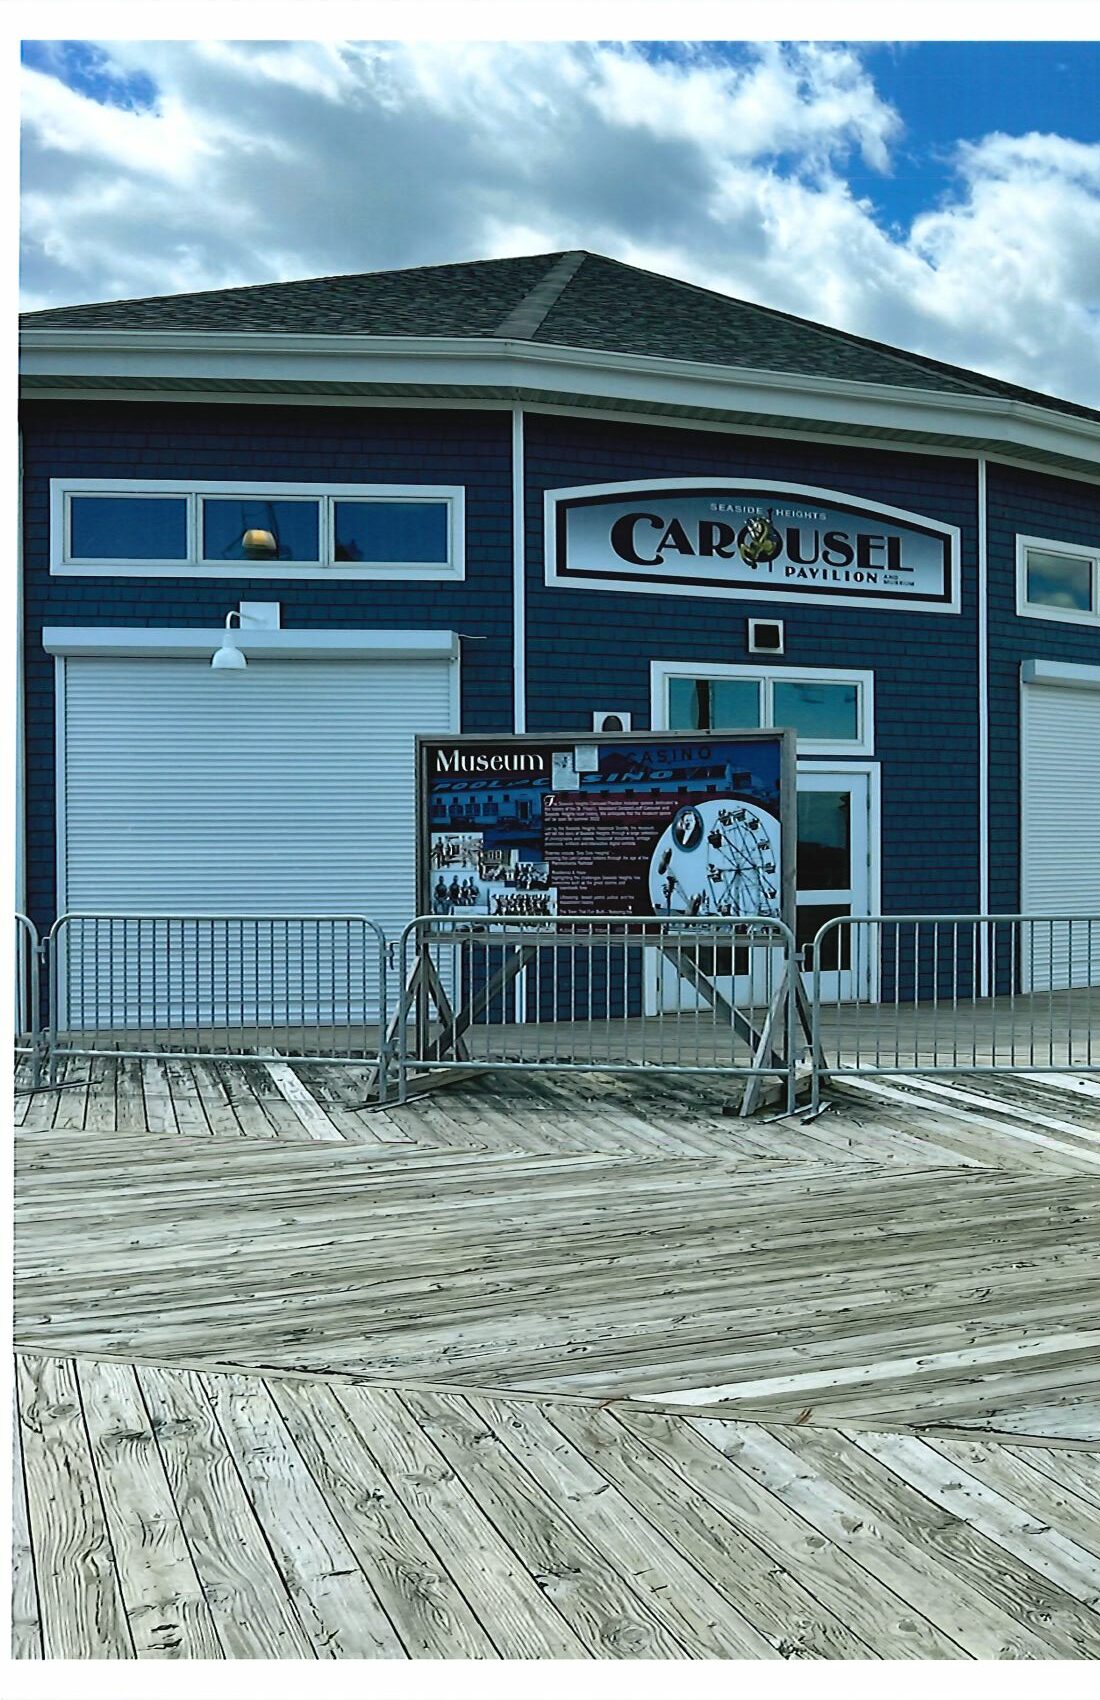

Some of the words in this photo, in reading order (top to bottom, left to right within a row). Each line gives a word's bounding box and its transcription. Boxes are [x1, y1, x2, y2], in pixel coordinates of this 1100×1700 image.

[710, 503, 763, 515] SEASIDE
[776, 509, 827, 521] HEIGHTS
[610, 512, 914, 572] CAROUSEL
[785, 566, 878, 584] PAVILION
[436, 749, 544, 772] Museum
[532, 769, 673, 786] CSINO
